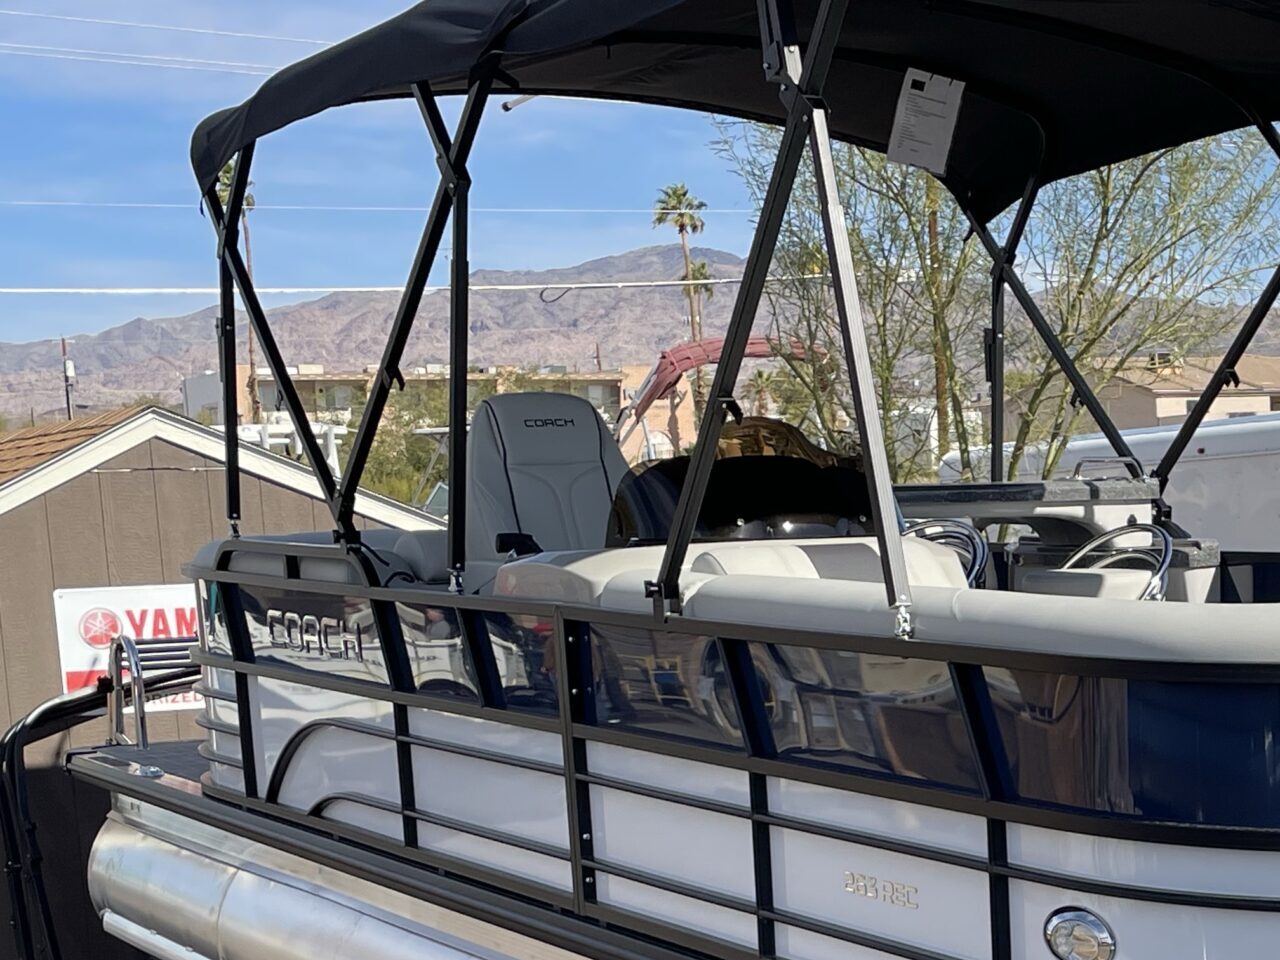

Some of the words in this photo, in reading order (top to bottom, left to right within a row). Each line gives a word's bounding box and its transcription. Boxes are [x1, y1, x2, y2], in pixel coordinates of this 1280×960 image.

[523, 418, 575, 428] COACH
[266, 609, 363, 663] COACH
[843, 871, 878, 900] 263
[881, 879, 920, 910] REC
